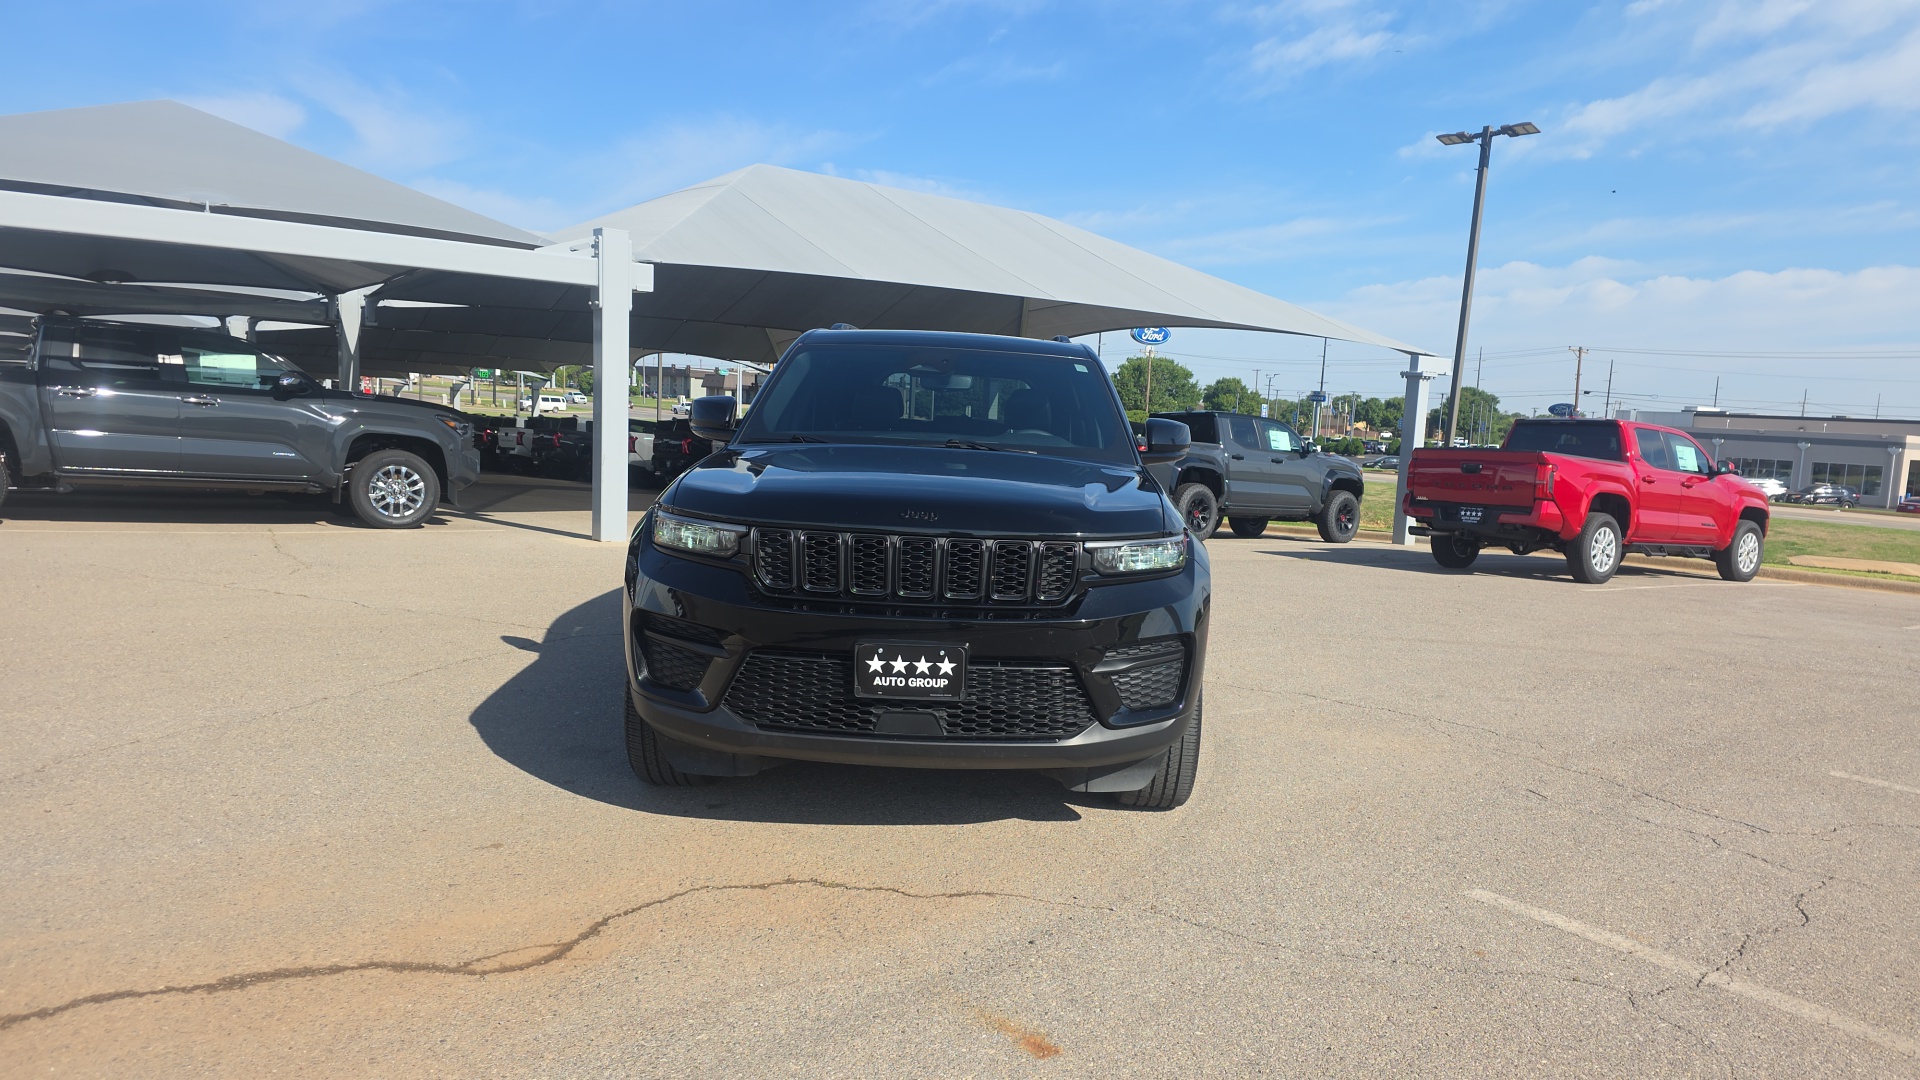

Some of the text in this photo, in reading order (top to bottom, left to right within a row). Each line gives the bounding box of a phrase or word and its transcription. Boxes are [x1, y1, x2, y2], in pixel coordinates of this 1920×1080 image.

[1142, 328, 1164, 340] Ford
[900, 507, 939, 521] Jeep
[873, 676, 949, 688] AUTO GROUP
